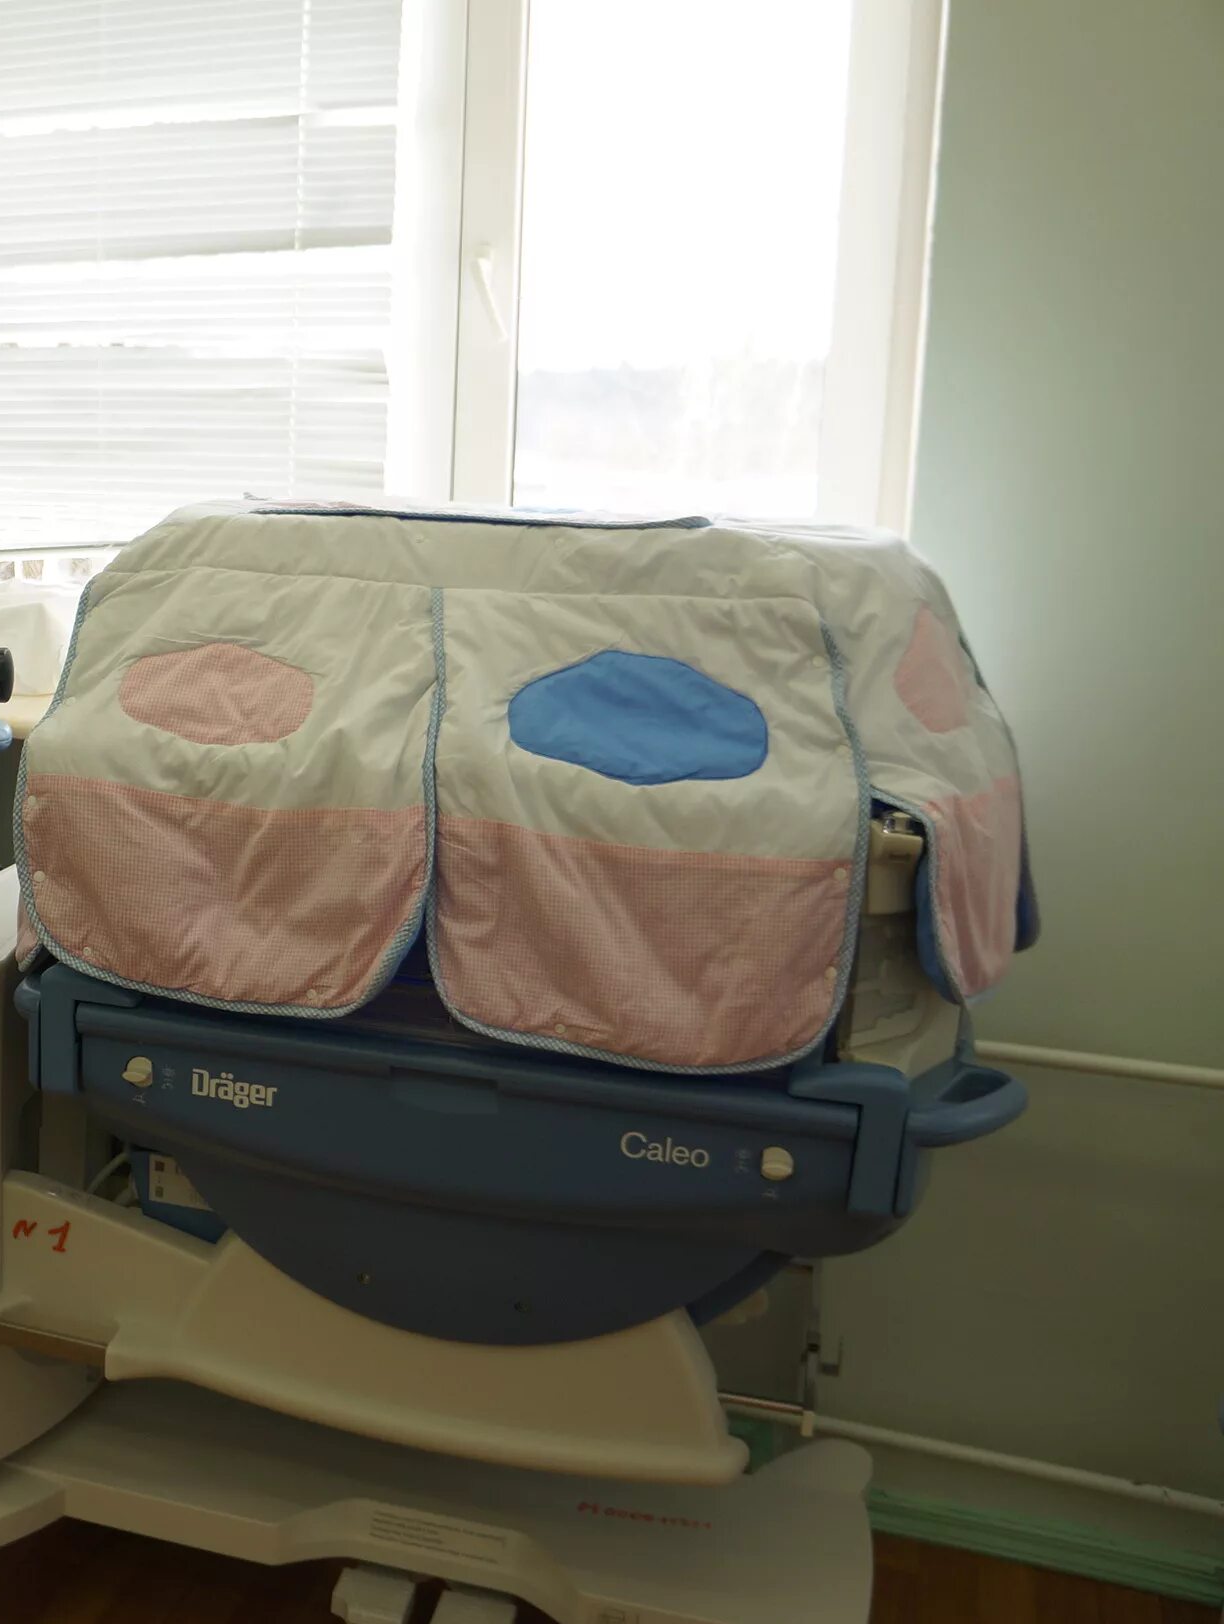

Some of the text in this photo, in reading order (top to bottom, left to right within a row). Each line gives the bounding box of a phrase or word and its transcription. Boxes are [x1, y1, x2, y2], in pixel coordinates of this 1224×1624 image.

[191, 1068, 278, 1109] Dräger
[620, 1131, 710, 1168] Caleo
[48, 1220, 72, 1252] 1
